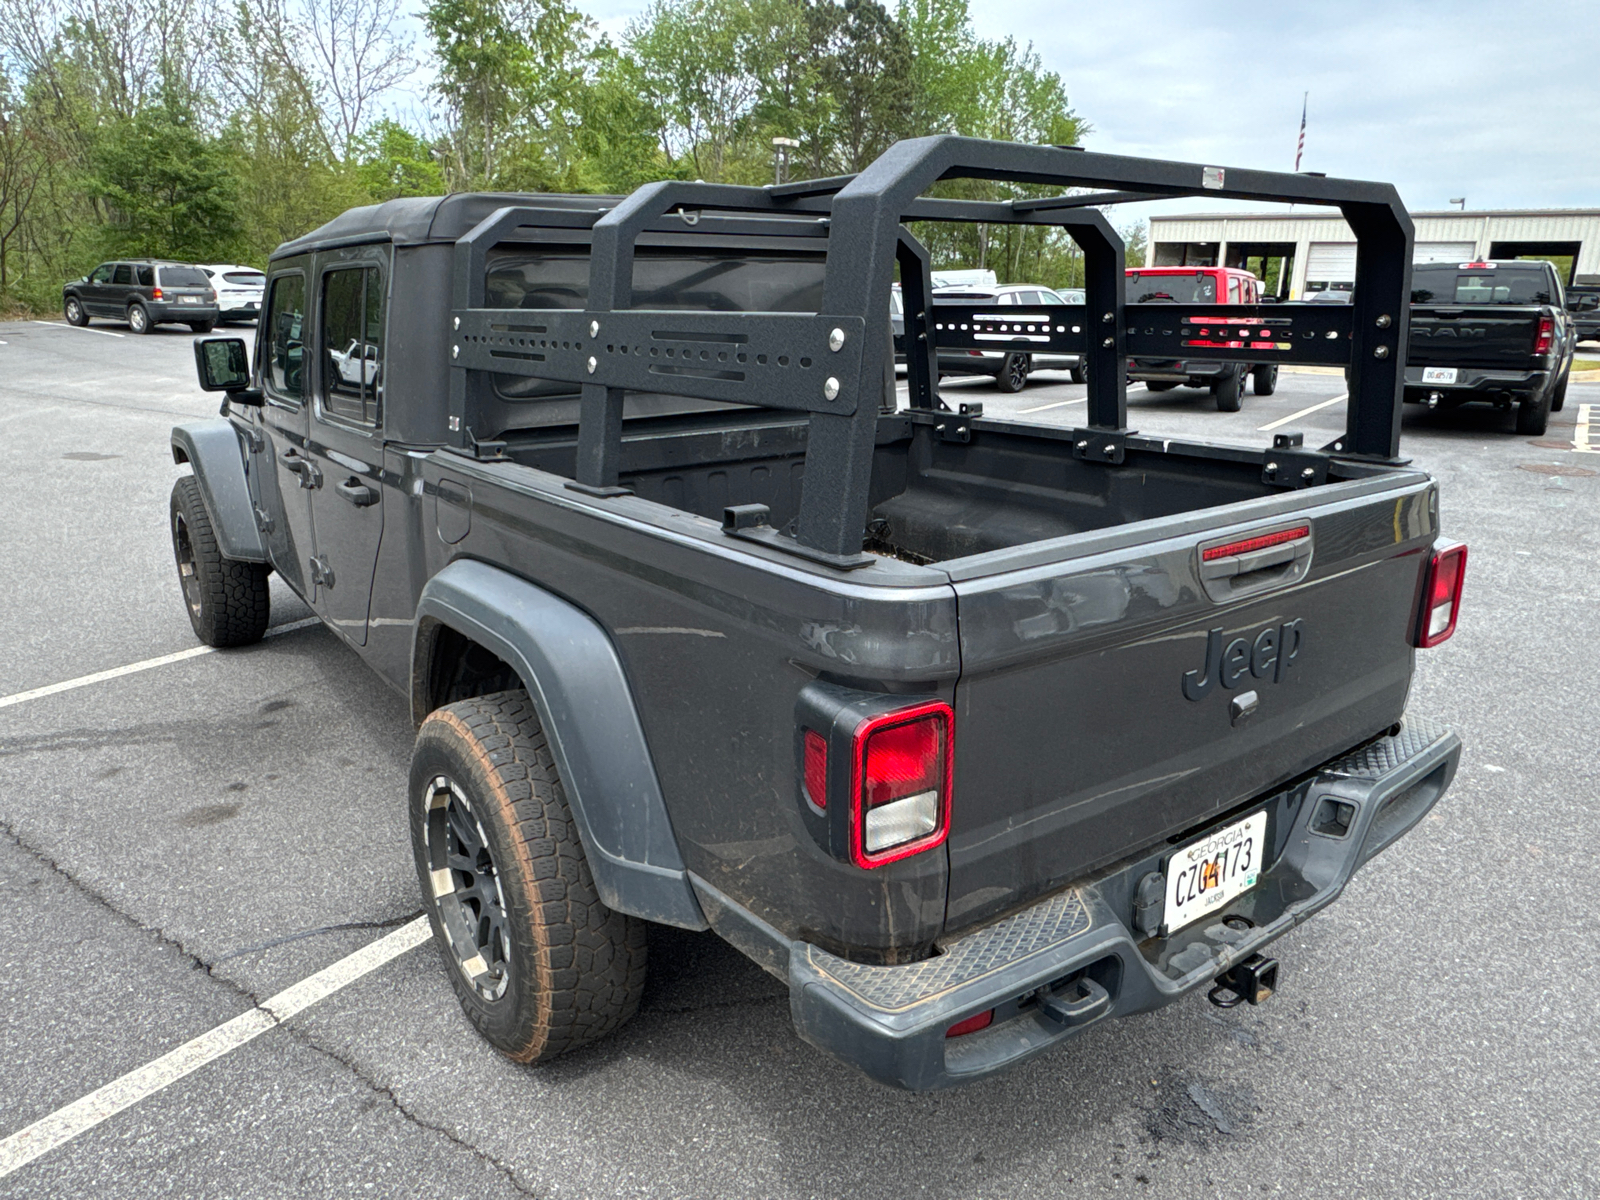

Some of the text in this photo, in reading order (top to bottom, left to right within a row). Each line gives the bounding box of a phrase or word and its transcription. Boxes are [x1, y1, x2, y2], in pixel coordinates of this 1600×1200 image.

[1409, 327, 1486, 338] RAM
[1182, 617, 1305, 702] Jeep
[1190, 828, 1243, 862] GEORGIA
[1175, 837, 1253, 907] CZG4173
